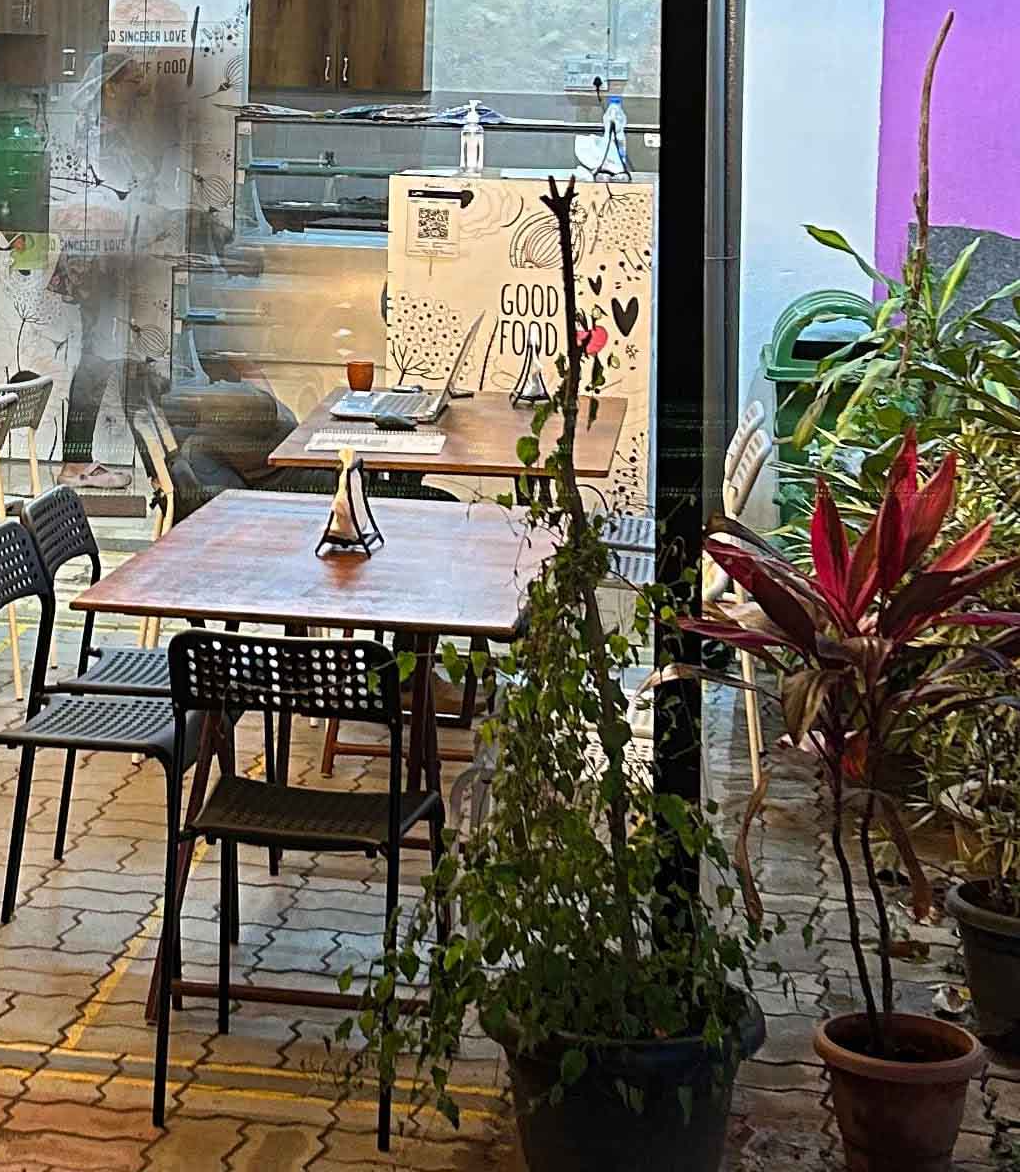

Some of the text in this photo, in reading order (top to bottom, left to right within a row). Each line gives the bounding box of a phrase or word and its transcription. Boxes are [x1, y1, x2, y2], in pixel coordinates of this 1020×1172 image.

[119, 30, 161, 43] SINCERER
[164, 29, 187, 43] LOVE
[157, 58, 187, 75] FOOD
[501, 283, 559, 318] GOOD
[500, 319, 558, 357] FOOD
